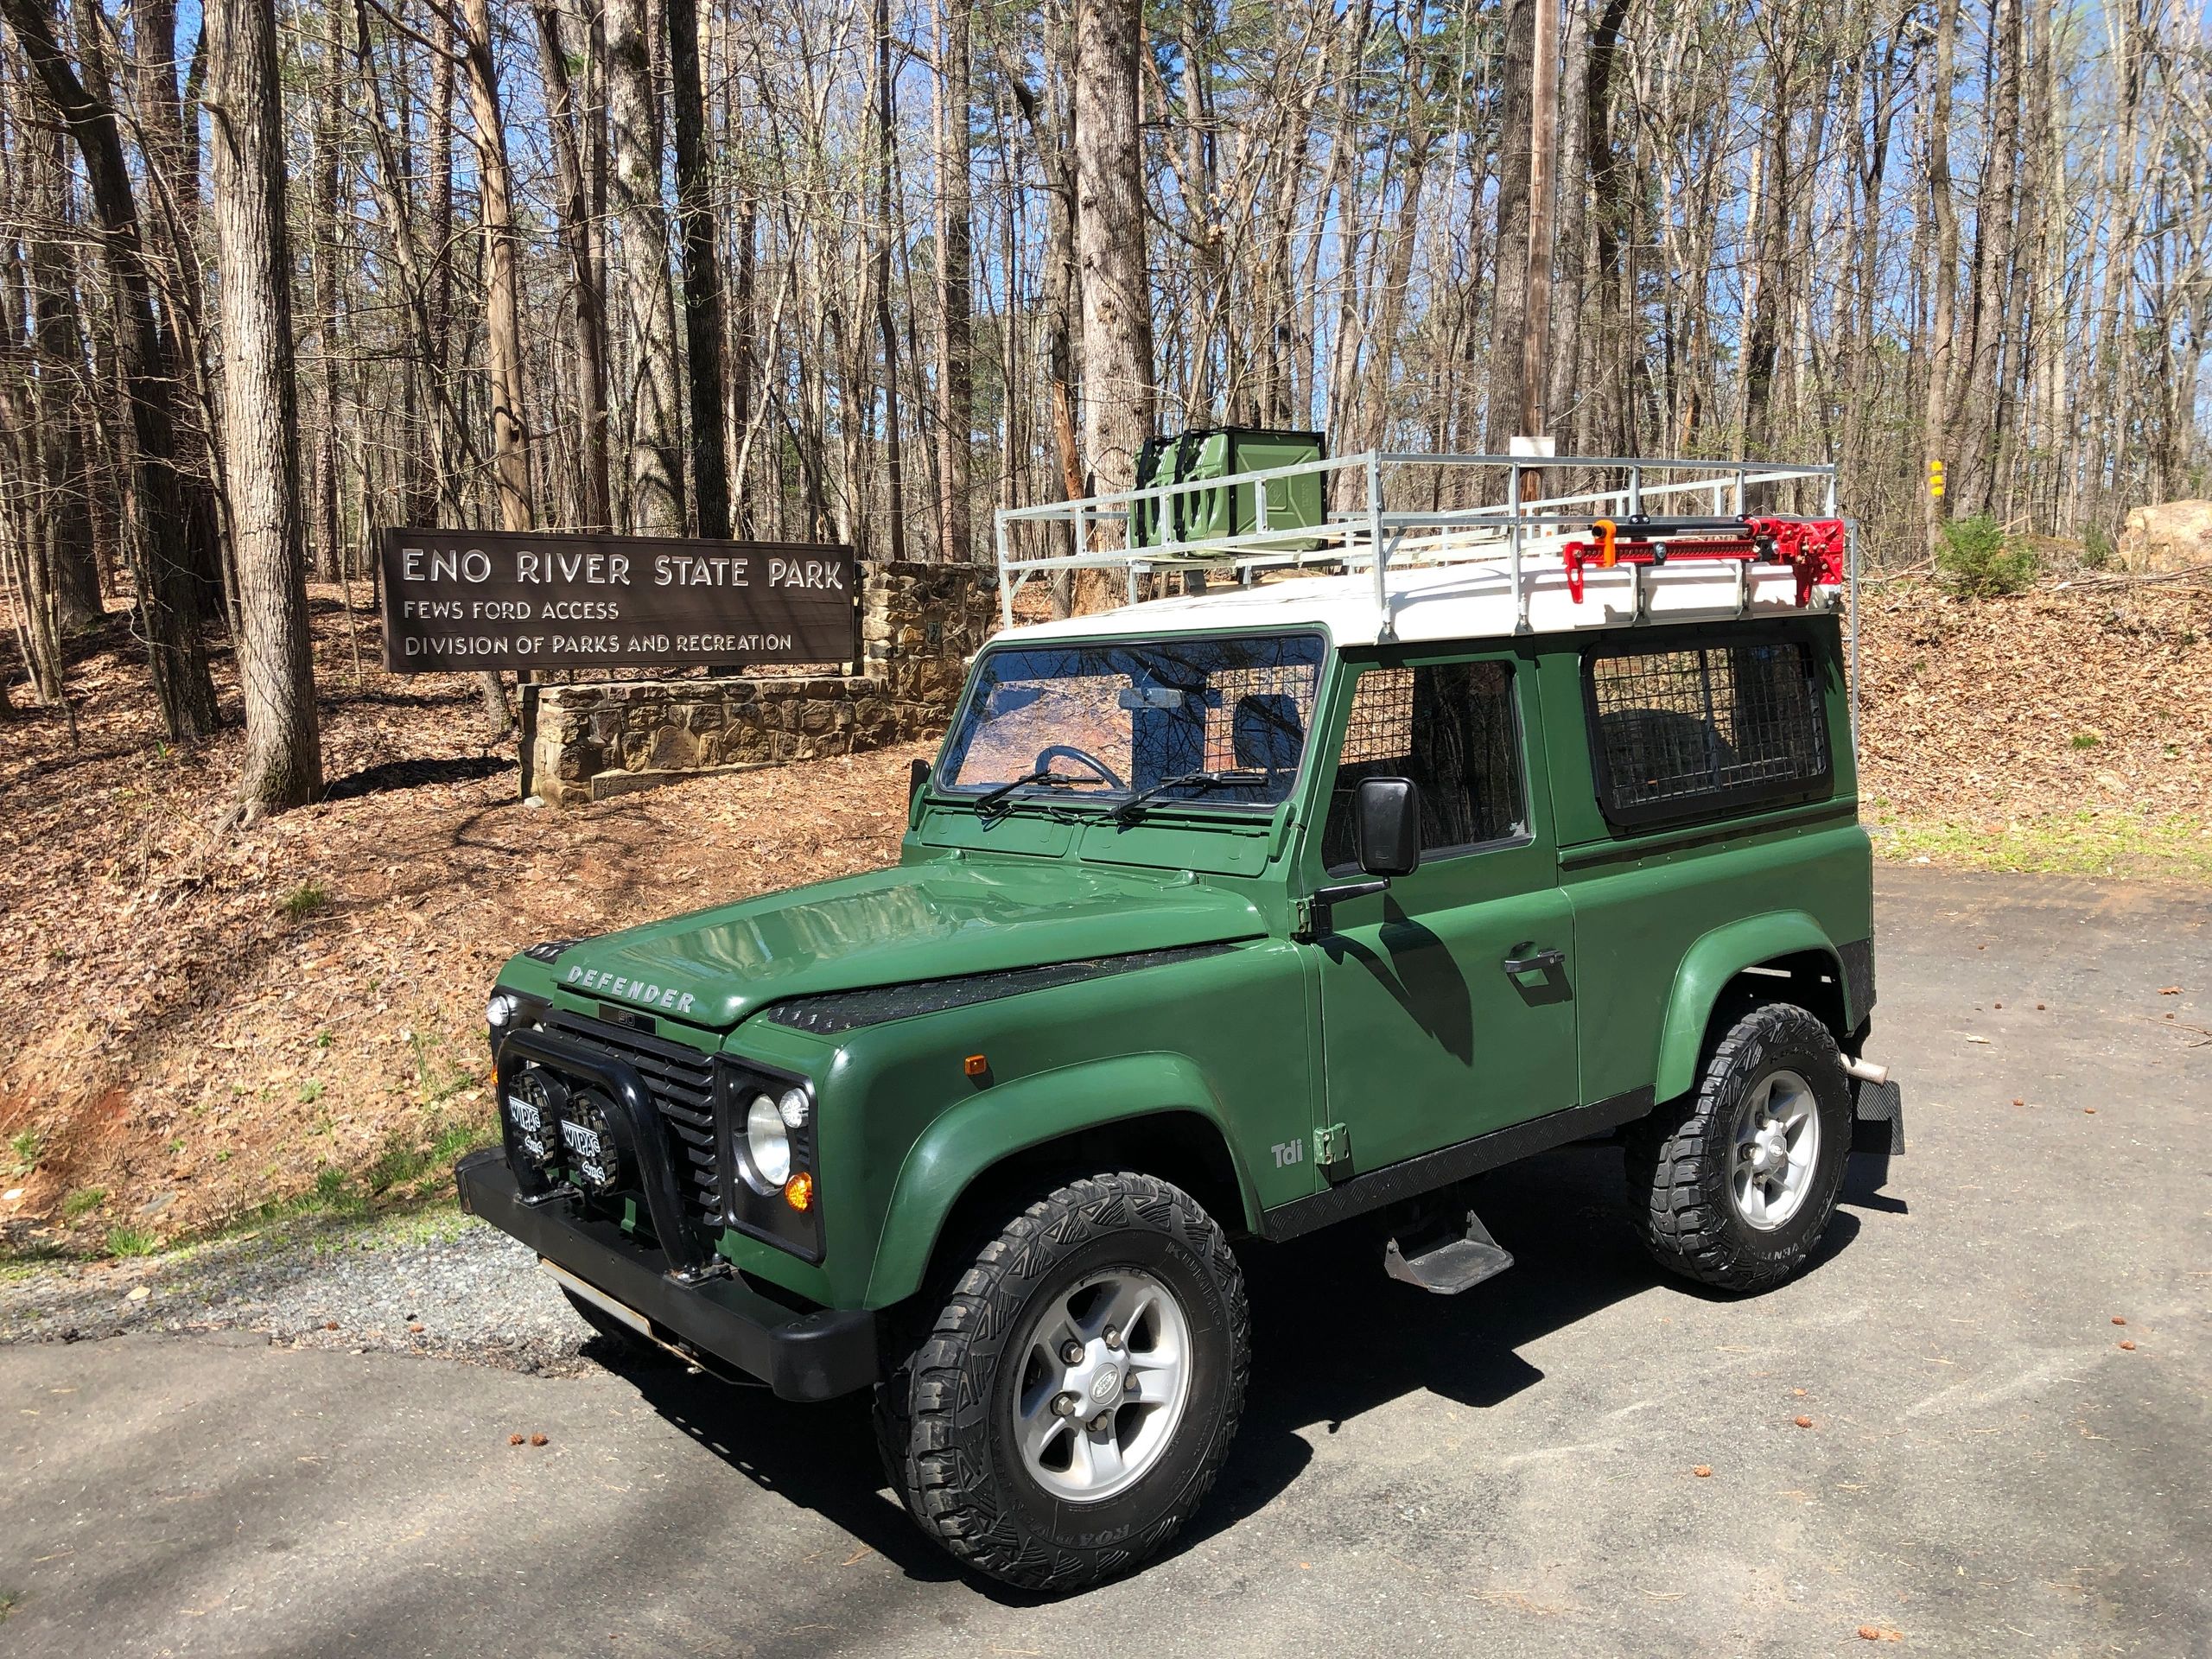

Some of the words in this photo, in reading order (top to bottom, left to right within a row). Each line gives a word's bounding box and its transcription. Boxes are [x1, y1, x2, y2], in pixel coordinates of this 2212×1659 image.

[403, 549, 491, 582] ENO
[518, 551, 630, 585] RIVER
[655, 555, 749, 587] STATE
[769, 558, 842, 589] PARK
[404, 601, 463, 619] FEWS
[473, 601, 531, 620] FORD
[542, 601, 620, 620] ACCESS
[405, 636, 508, 656] DIVISION
[516, 636, 544, 654] OF
[553, 635, 620, 653] PARKS
[627, 635, 670, 652] AND
[677, 633, 791, 652] RECREATION
[567, 965, 696, 1014] DEFENDER
[618, 1010, 635, 1027] 90
[509, 1099, 541, 1133] WIPAC
[562, 1123, 601, 1158] WIPAC
[1271, 1138, 1303, 1168] Tdi
